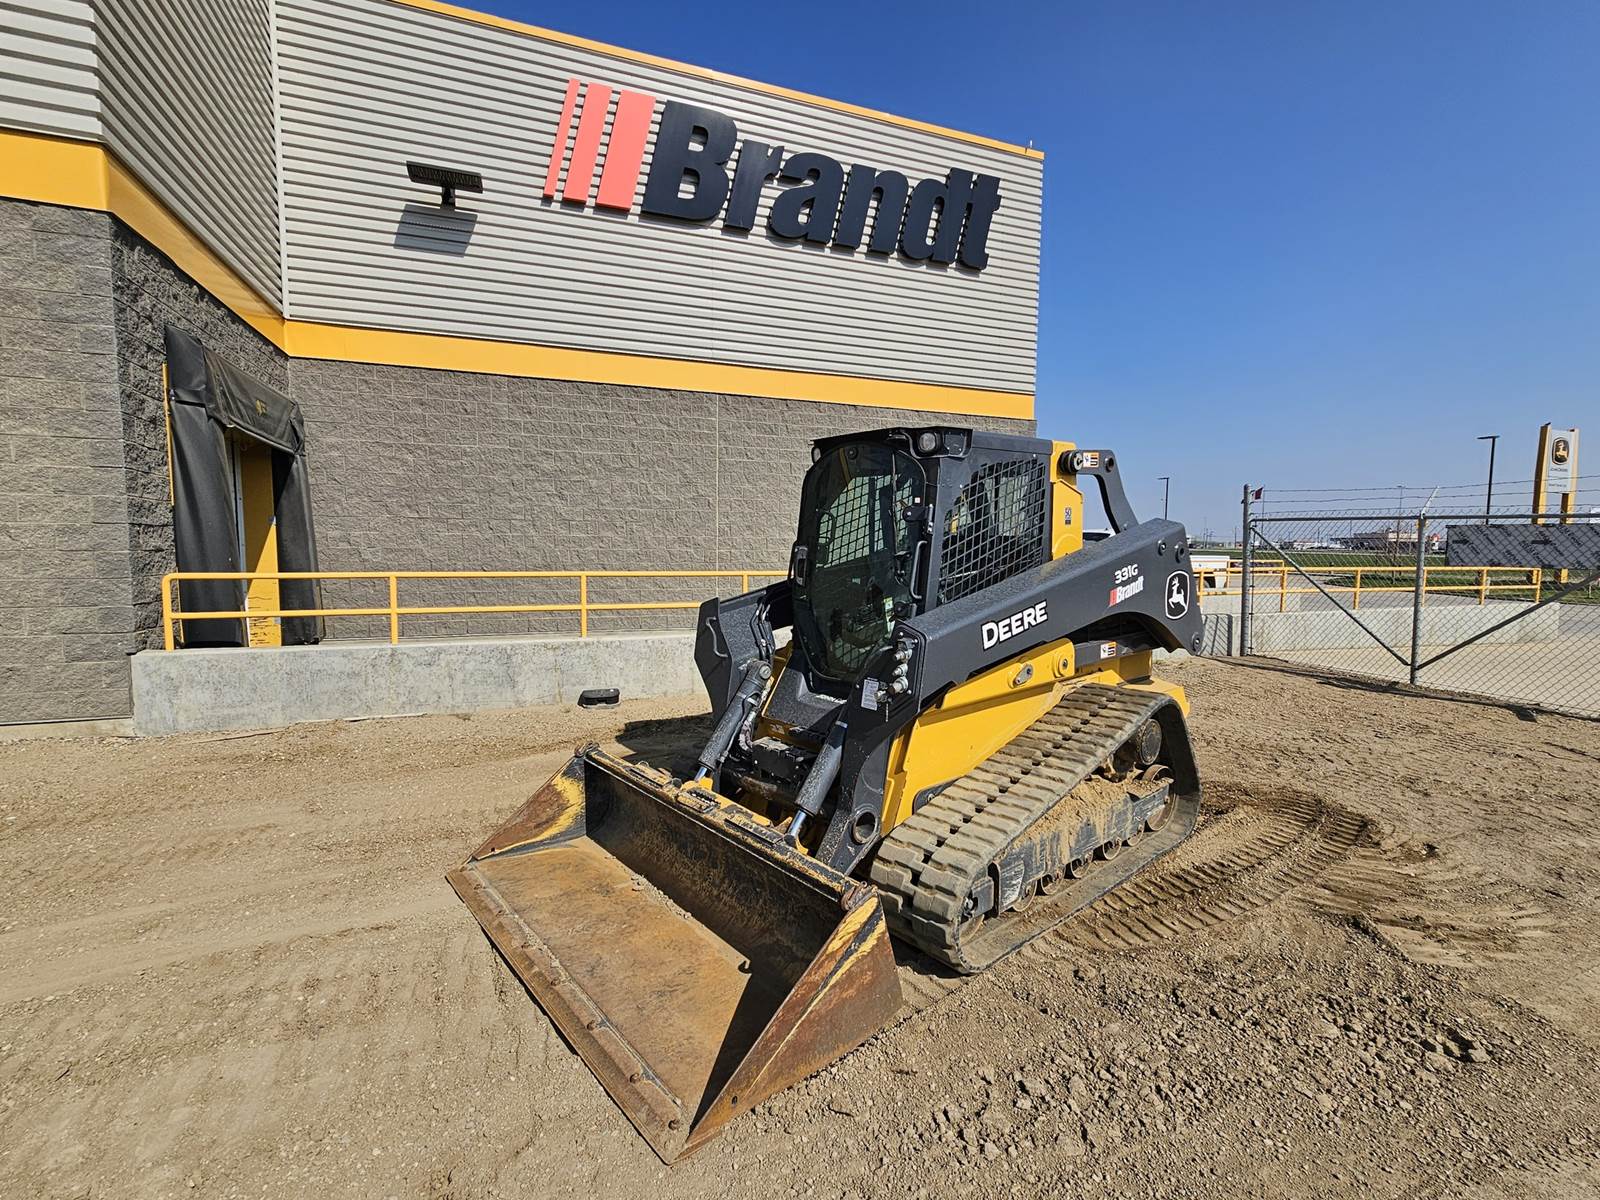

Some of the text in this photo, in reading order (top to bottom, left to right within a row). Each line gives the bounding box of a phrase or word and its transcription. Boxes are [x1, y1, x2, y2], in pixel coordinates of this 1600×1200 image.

[641, 100, 1001, 270] Brandt
[1114, 563, 1139, 584] 331G
[1116, 575, 1144, 604] Brandt
[981, 600, 1049, 650] DEERE
